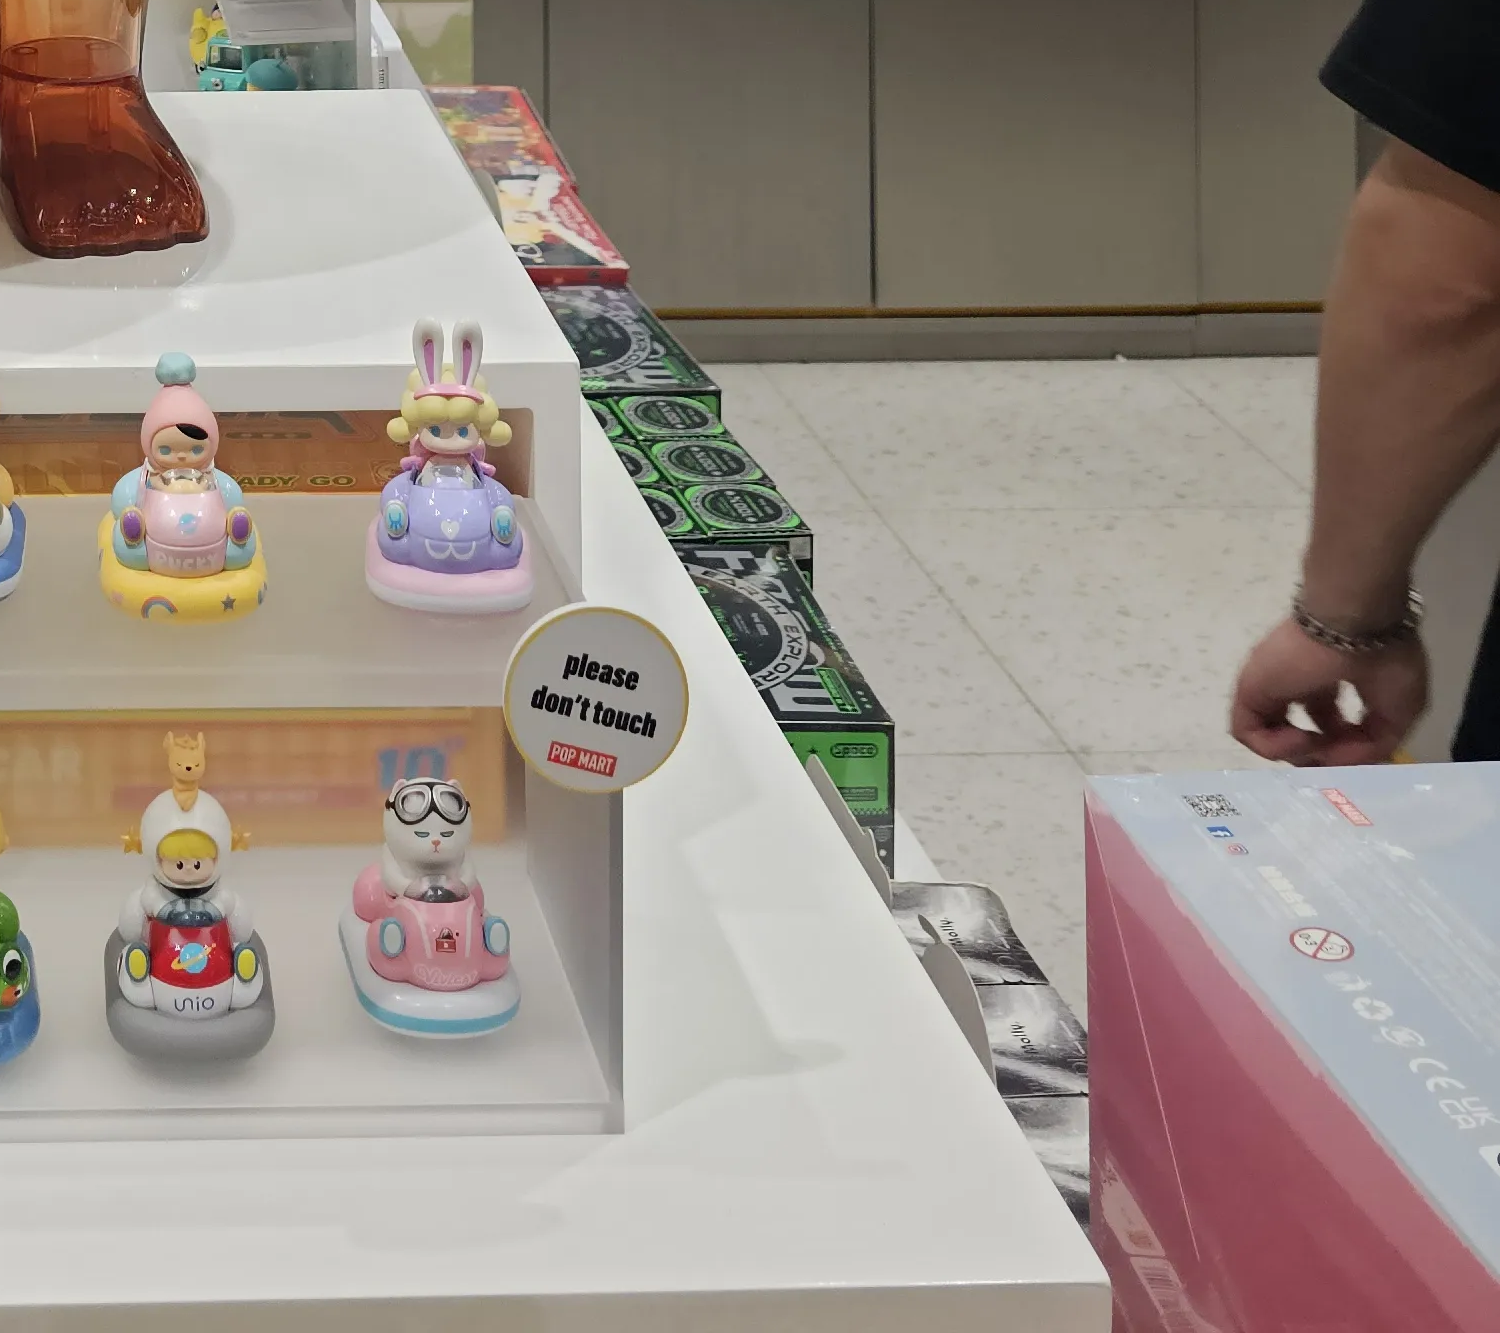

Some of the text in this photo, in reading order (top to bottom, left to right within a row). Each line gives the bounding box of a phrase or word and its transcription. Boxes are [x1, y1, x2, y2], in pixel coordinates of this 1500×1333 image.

[308, 474, 356, 487] GO
[562, 652, 640, 691] please
[531, 685, 657, 739] don't touch
[551, 744, 614, 774] POP MART
